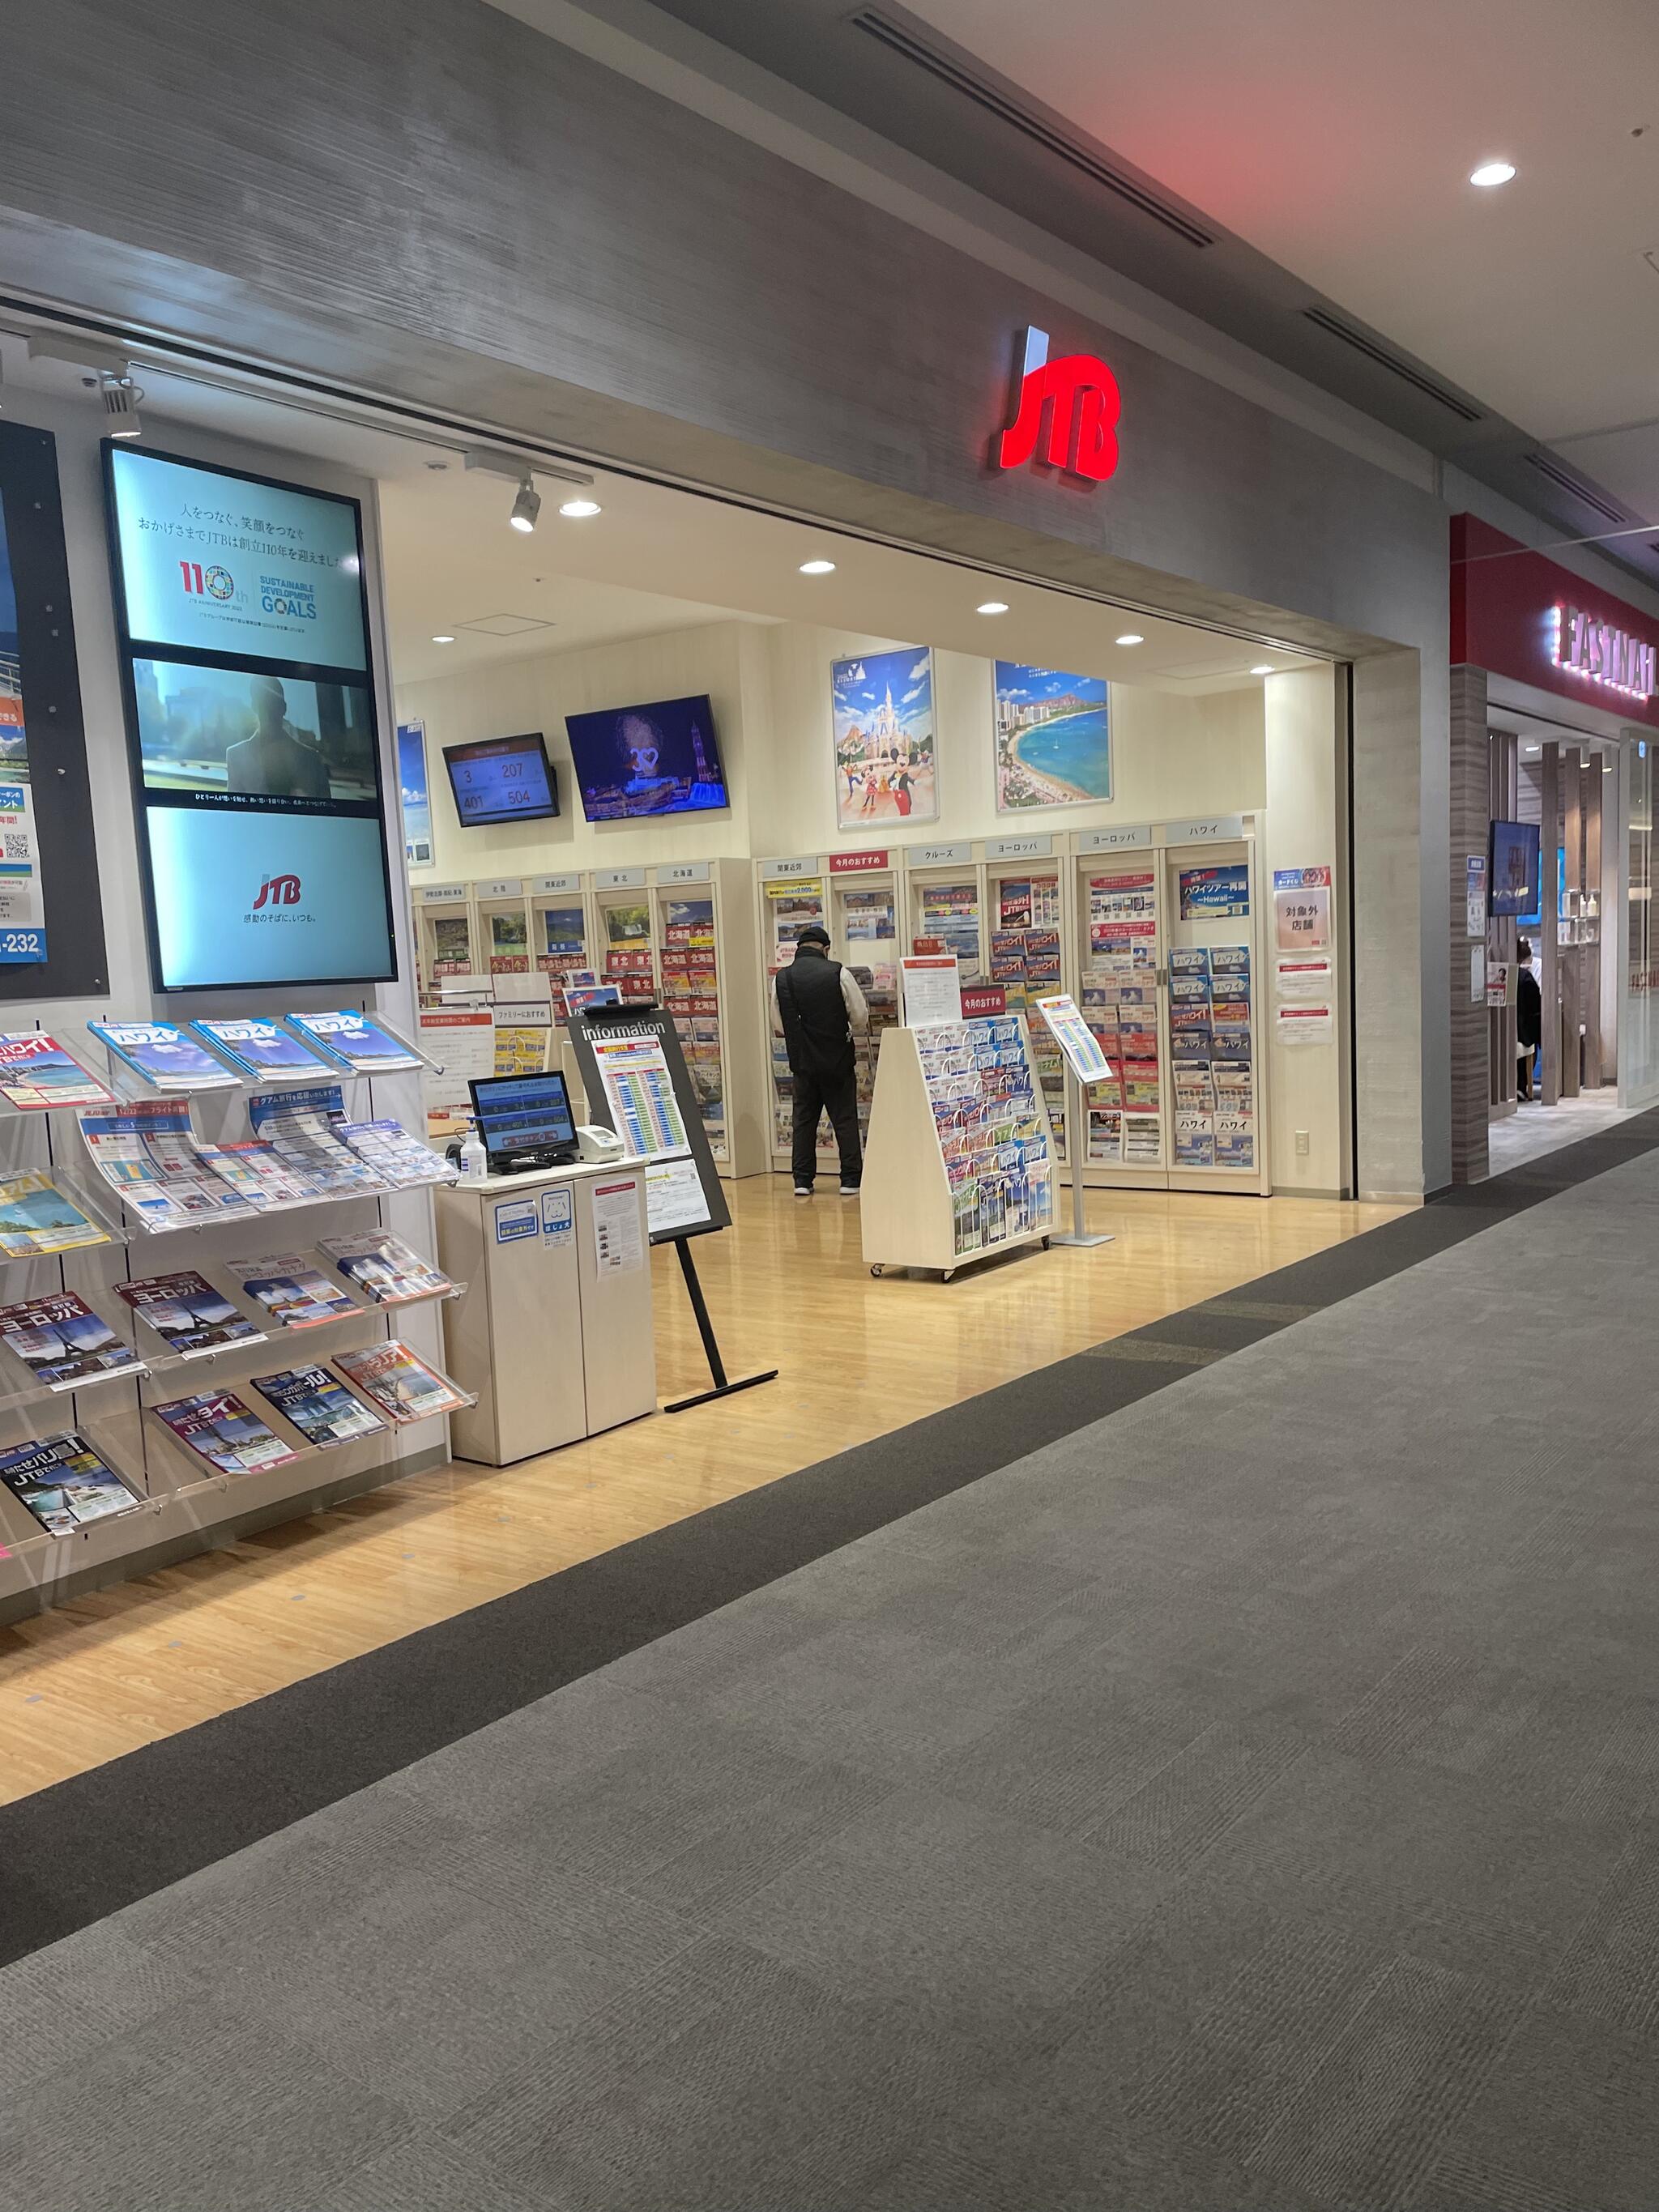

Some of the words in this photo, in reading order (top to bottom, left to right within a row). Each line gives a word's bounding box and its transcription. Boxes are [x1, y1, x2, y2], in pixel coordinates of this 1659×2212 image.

[1000, 325, 1121, 480] JTB
[260, 575, 314, 593] SUSTAINABLE
[261, 586, 314, 603] DEVELOPMENT
[262, 595, 317, 620] GOALS
[464, 770, 471, 783] 3
[501, 763, 522, 778] 207
[464, 795, 484, 809] 401
[508, 791, 531, 804] 504
[1189, 824, 1218, 836] ハワイ
[1094, 833, 1135, 845] ヨーロッパ
[998, 842, 1038, 853] ヨーロッパ
[925, 849, 953, 859] クルーズ
[835, 857, 881, 867] 今月のおすすめ
[673, 869, 693, 878] 北海道
[254, 874, 301, 910] JTB
[1184, 881, 1247, 895] ハワイツアー再開
[1286, 904, 1318, 918] 対象外
[243, 914, 316, 923] 感動のそばに、いつも。
[1292, 919, 1313, 931] 店舗
[612, 956, 629, 966] 東北
[664, 954, 687, 965] 北海道
[691, 953, 714, 964] 北海道
[1177, 955, 1199, 965] ハワイ
[1218, 953, 1240, 963] ハワイ
[1177, 983, 1199, 994] ハワイ
[1217, 982, 1240, 992] ハワイ
[694, 1000, 717, 1012] 北海道
[965, 996, 1001, 1010] 今月のおすすめ
[499, 1010, 545, 1020] ファミリーにおすすめ
[315, 1019, 356, 1031] ハワイ
[581, 1021, 666, 1041] information
[120, 1031, 168, 1042] ハワイ
[224, 1027, 267, 1038] ハワイ
[1184, 1040, 1207, 1050] ハワイ
[1225, 1040, 1249, 1050] ハワイ
[1180, 1119, 1206, 1130] ハワイ
[1220, 1121, 1247, 1131] ハワイ
[544, 1221, 570, 1233] ほじょ犬
[133, 1283, 207, 1304] ヨーロッパ
[0, 1306, 84, 1333] ヨーロッパ
